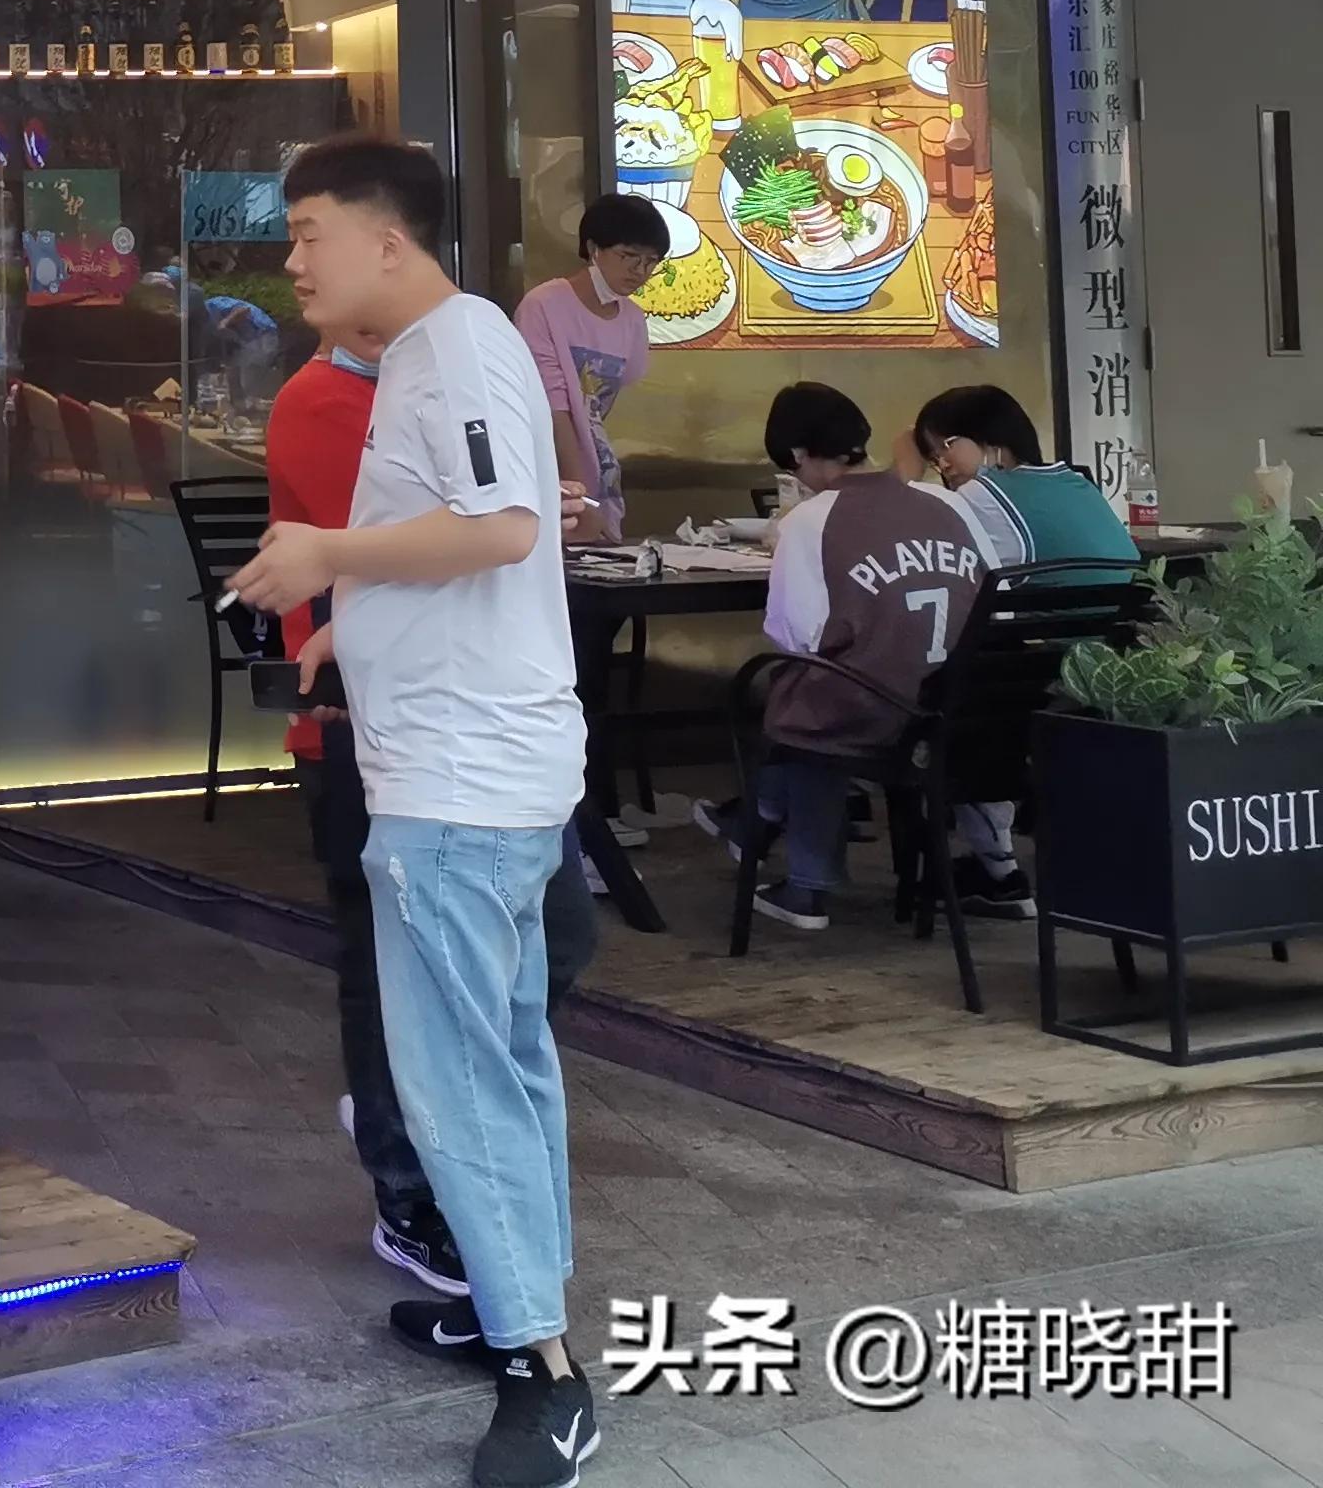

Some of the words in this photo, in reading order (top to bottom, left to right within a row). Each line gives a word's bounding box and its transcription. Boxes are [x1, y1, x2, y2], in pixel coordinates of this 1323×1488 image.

[1068, 69, 1099, 91] 100
[1066, 110, 1100, 125] FUN
[1067, 140, 1107, 155] CITY
[847, 538, 981, 597] PLAYER
[904, 586, 950, 665] 7
[1186, 789, 1323, 862] SUSHI
